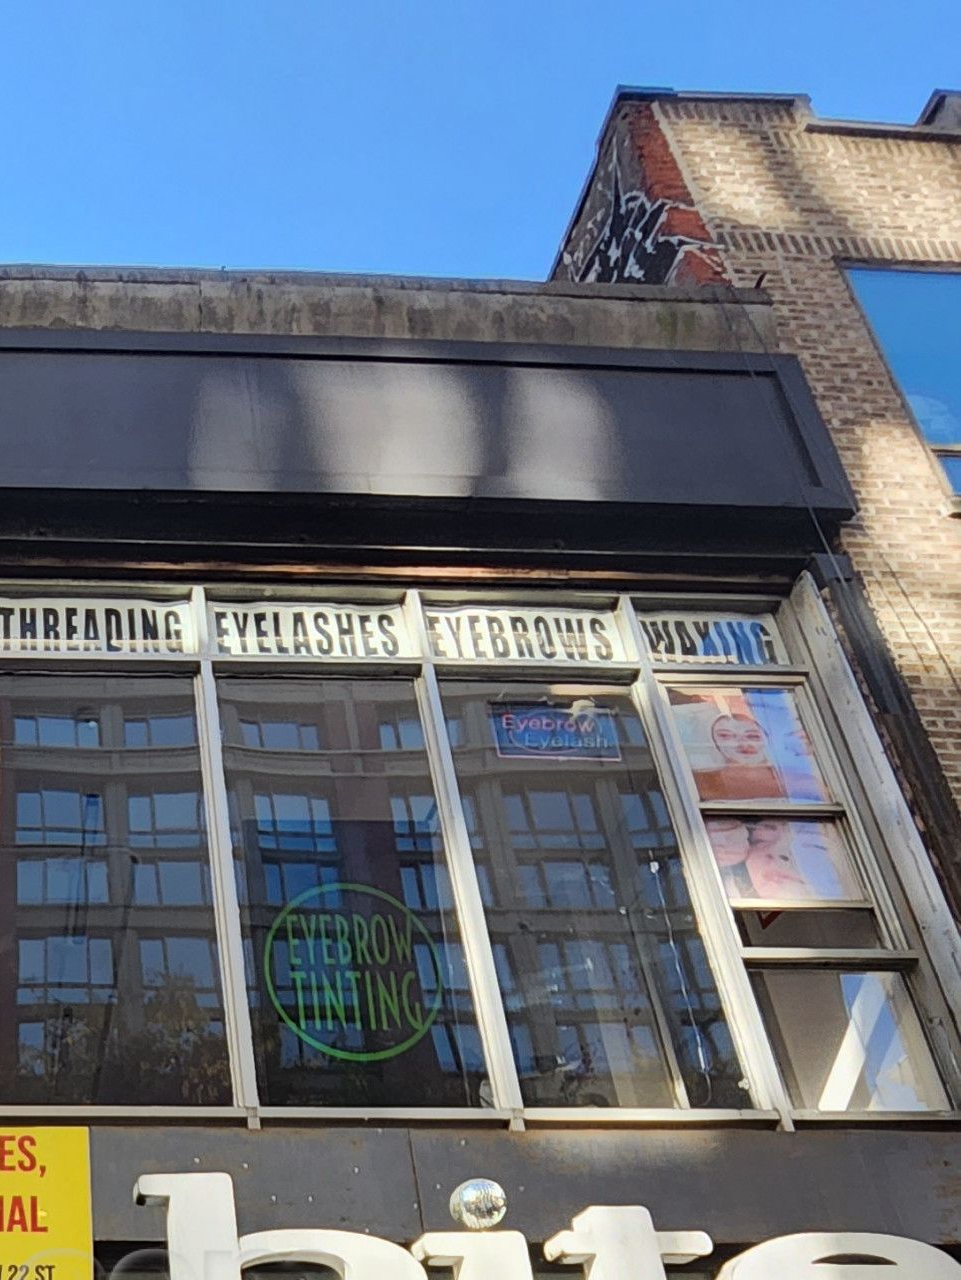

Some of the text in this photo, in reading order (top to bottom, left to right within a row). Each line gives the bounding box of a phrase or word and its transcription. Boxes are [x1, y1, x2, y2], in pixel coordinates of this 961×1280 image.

[0, 606, 181, 653] THREADING
[216, 611, 398, 657] EYELASHES
[427, 615, 614, 662] EYEBROWS
[639, 620, 779, 665] WAXING
[502, 712, 595, 733] Eyebrow
[524, 733, 609, 749] Eyelash
[287, 914, 414, 966] EYEBROW
[290, 970, 424, 1031] TINTING
